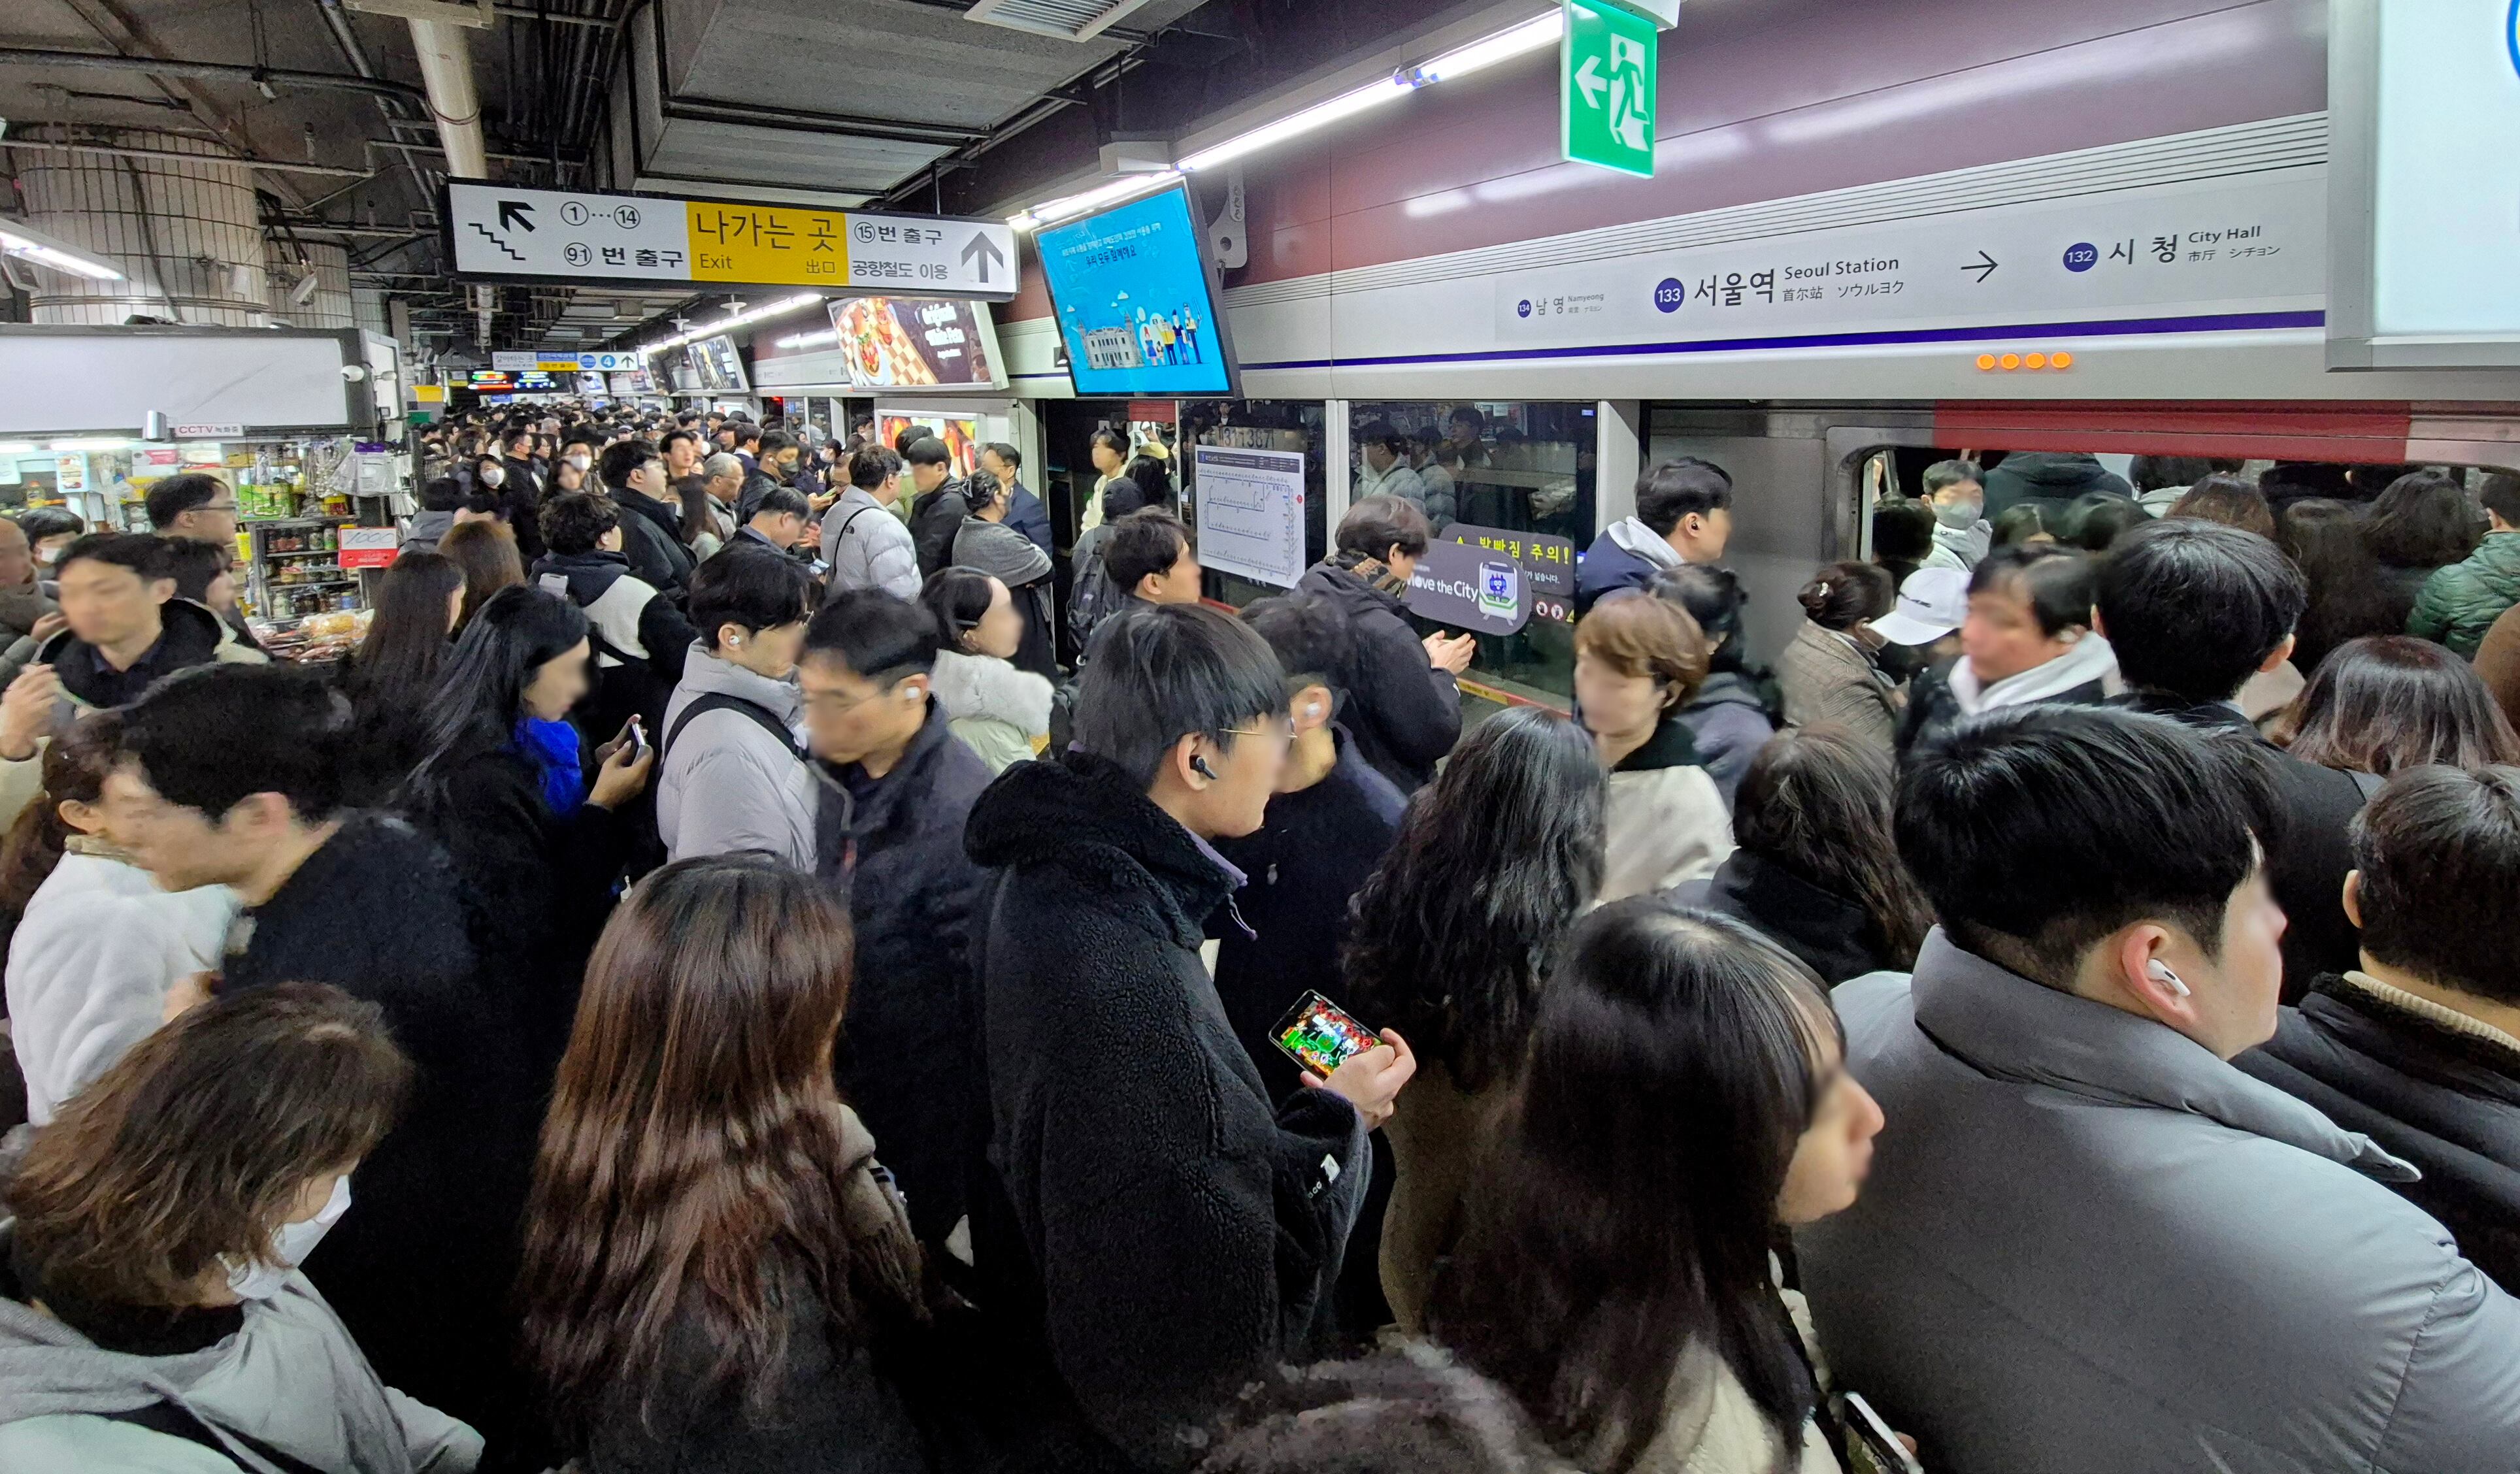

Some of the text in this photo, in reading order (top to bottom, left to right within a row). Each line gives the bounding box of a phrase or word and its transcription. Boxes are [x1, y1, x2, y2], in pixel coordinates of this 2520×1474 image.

[696, 210, 837, 252] 나가는 곳
[903, 227, 943, 245] 출구
[2188, 225, 2261, 244] City Hall
[602, 246, 626, 266] 번
[635, 248, 684, 268] 출구
[700, 253, 733, 270] Exit
[2067, 250, 2093, 263] 132
[2188, 250, 2216, 263] 市厅
[806, 258, 835, 274] 出口
[852, 260, 948, 280] 공항철도 이용
[1784, 257, 1899, 280] Seoul Station
[1657, 287, 1681, 303] 133
[1694, 268, 1775, 307] 서울역
[1782, 286, 1824, 303] 首尔站
[1568, 293, 1604, 303] Namyeong
[178, 425, 213, 434] CCTV
[344, 531, 395, 545] 1000
[1530, 543, 1570, 565] 주의!
[1437, 580, 1453, 595] the
[1453, 580, 1479, 603] City
